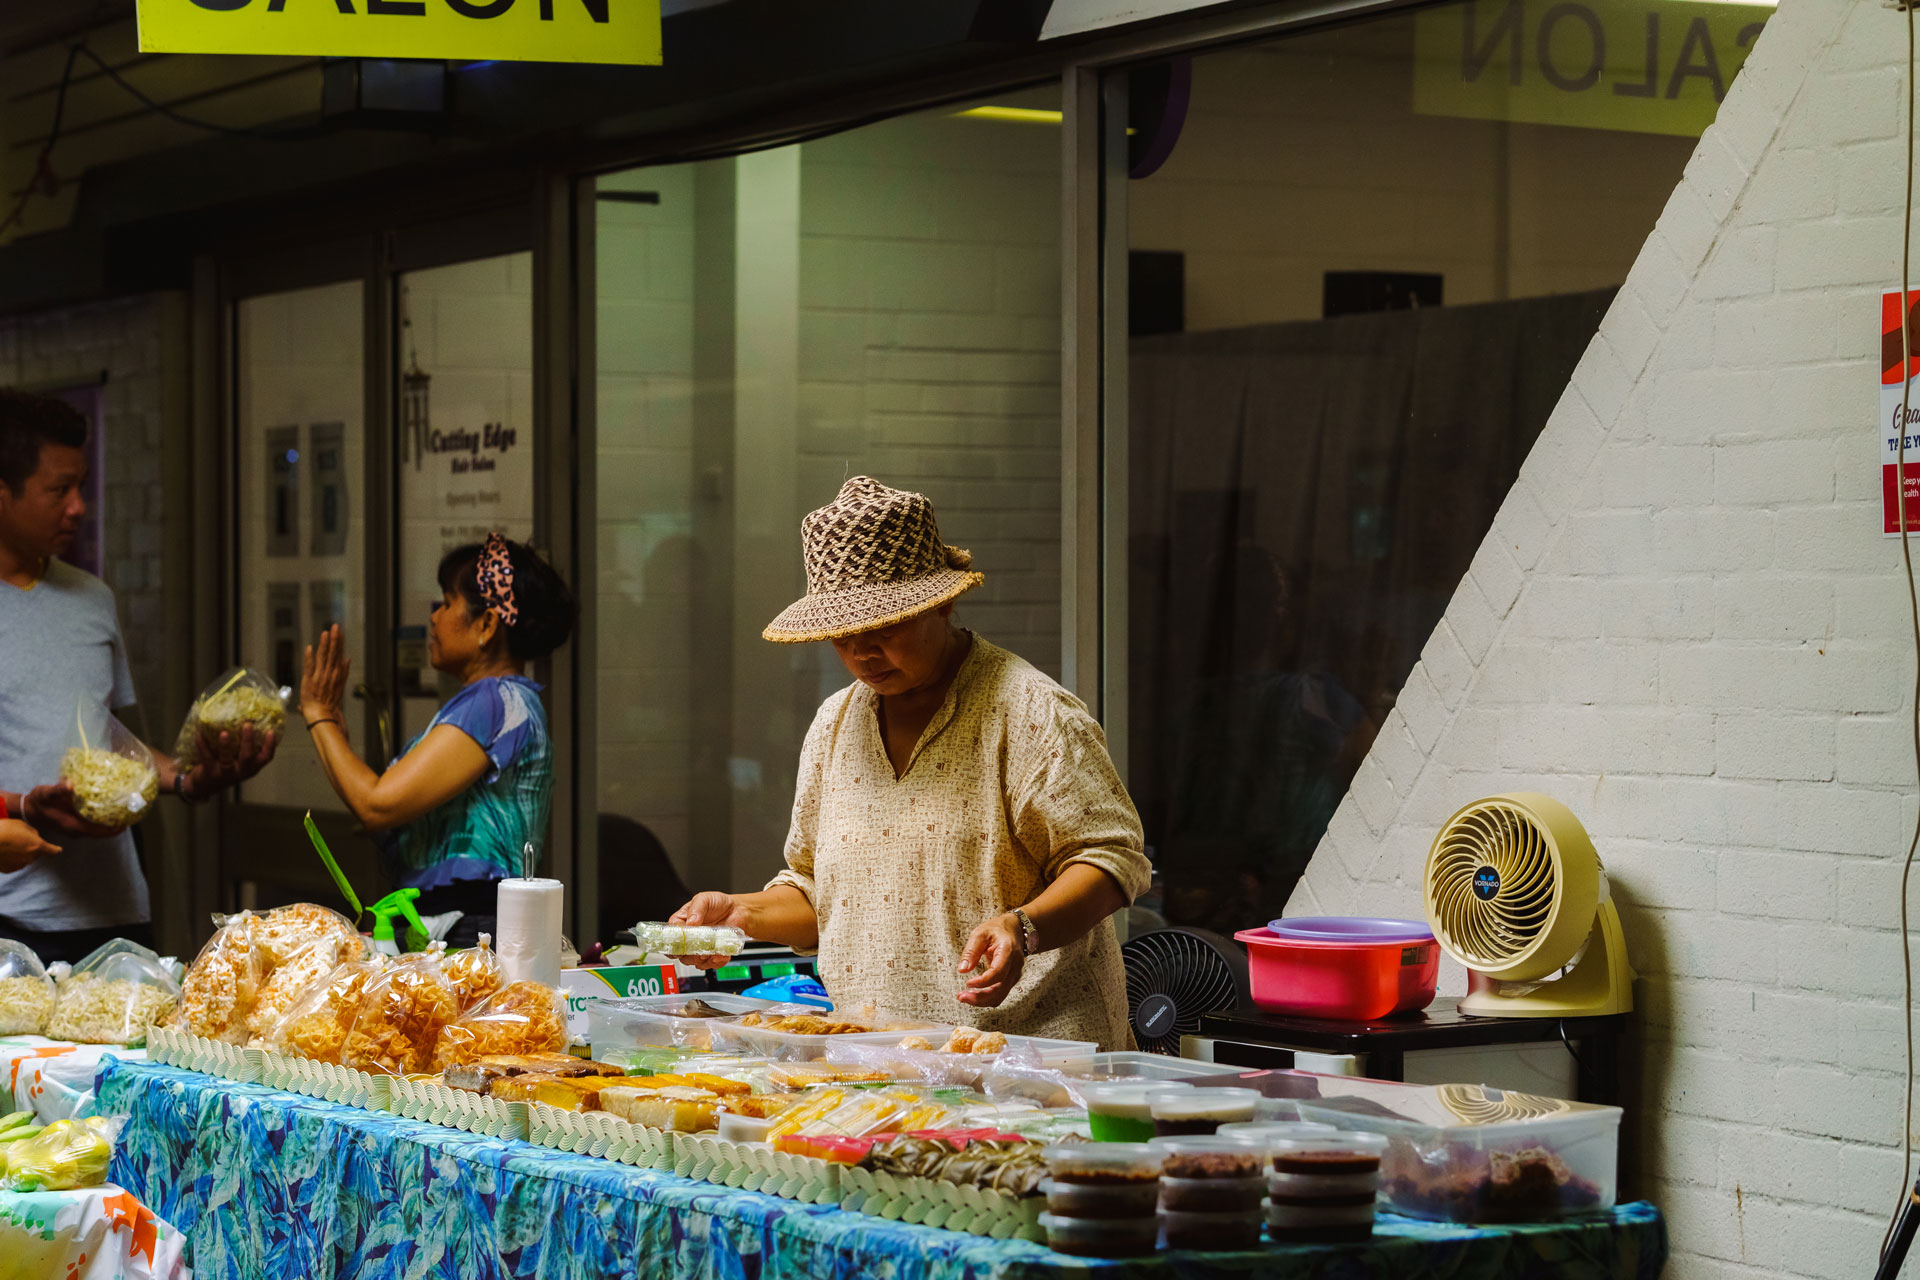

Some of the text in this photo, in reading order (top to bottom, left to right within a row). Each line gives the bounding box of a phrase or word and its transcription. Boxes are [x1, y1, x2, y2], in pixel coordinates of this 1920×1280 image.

[430, 422, 517, 455] Cutting Edge
[1888, 435, 1912, 451] TAE
[1904, 489, 1919, 498] ealth
[1474, 880, 1499, 888] VORNADO
[628, 978, 660, 997] 600
